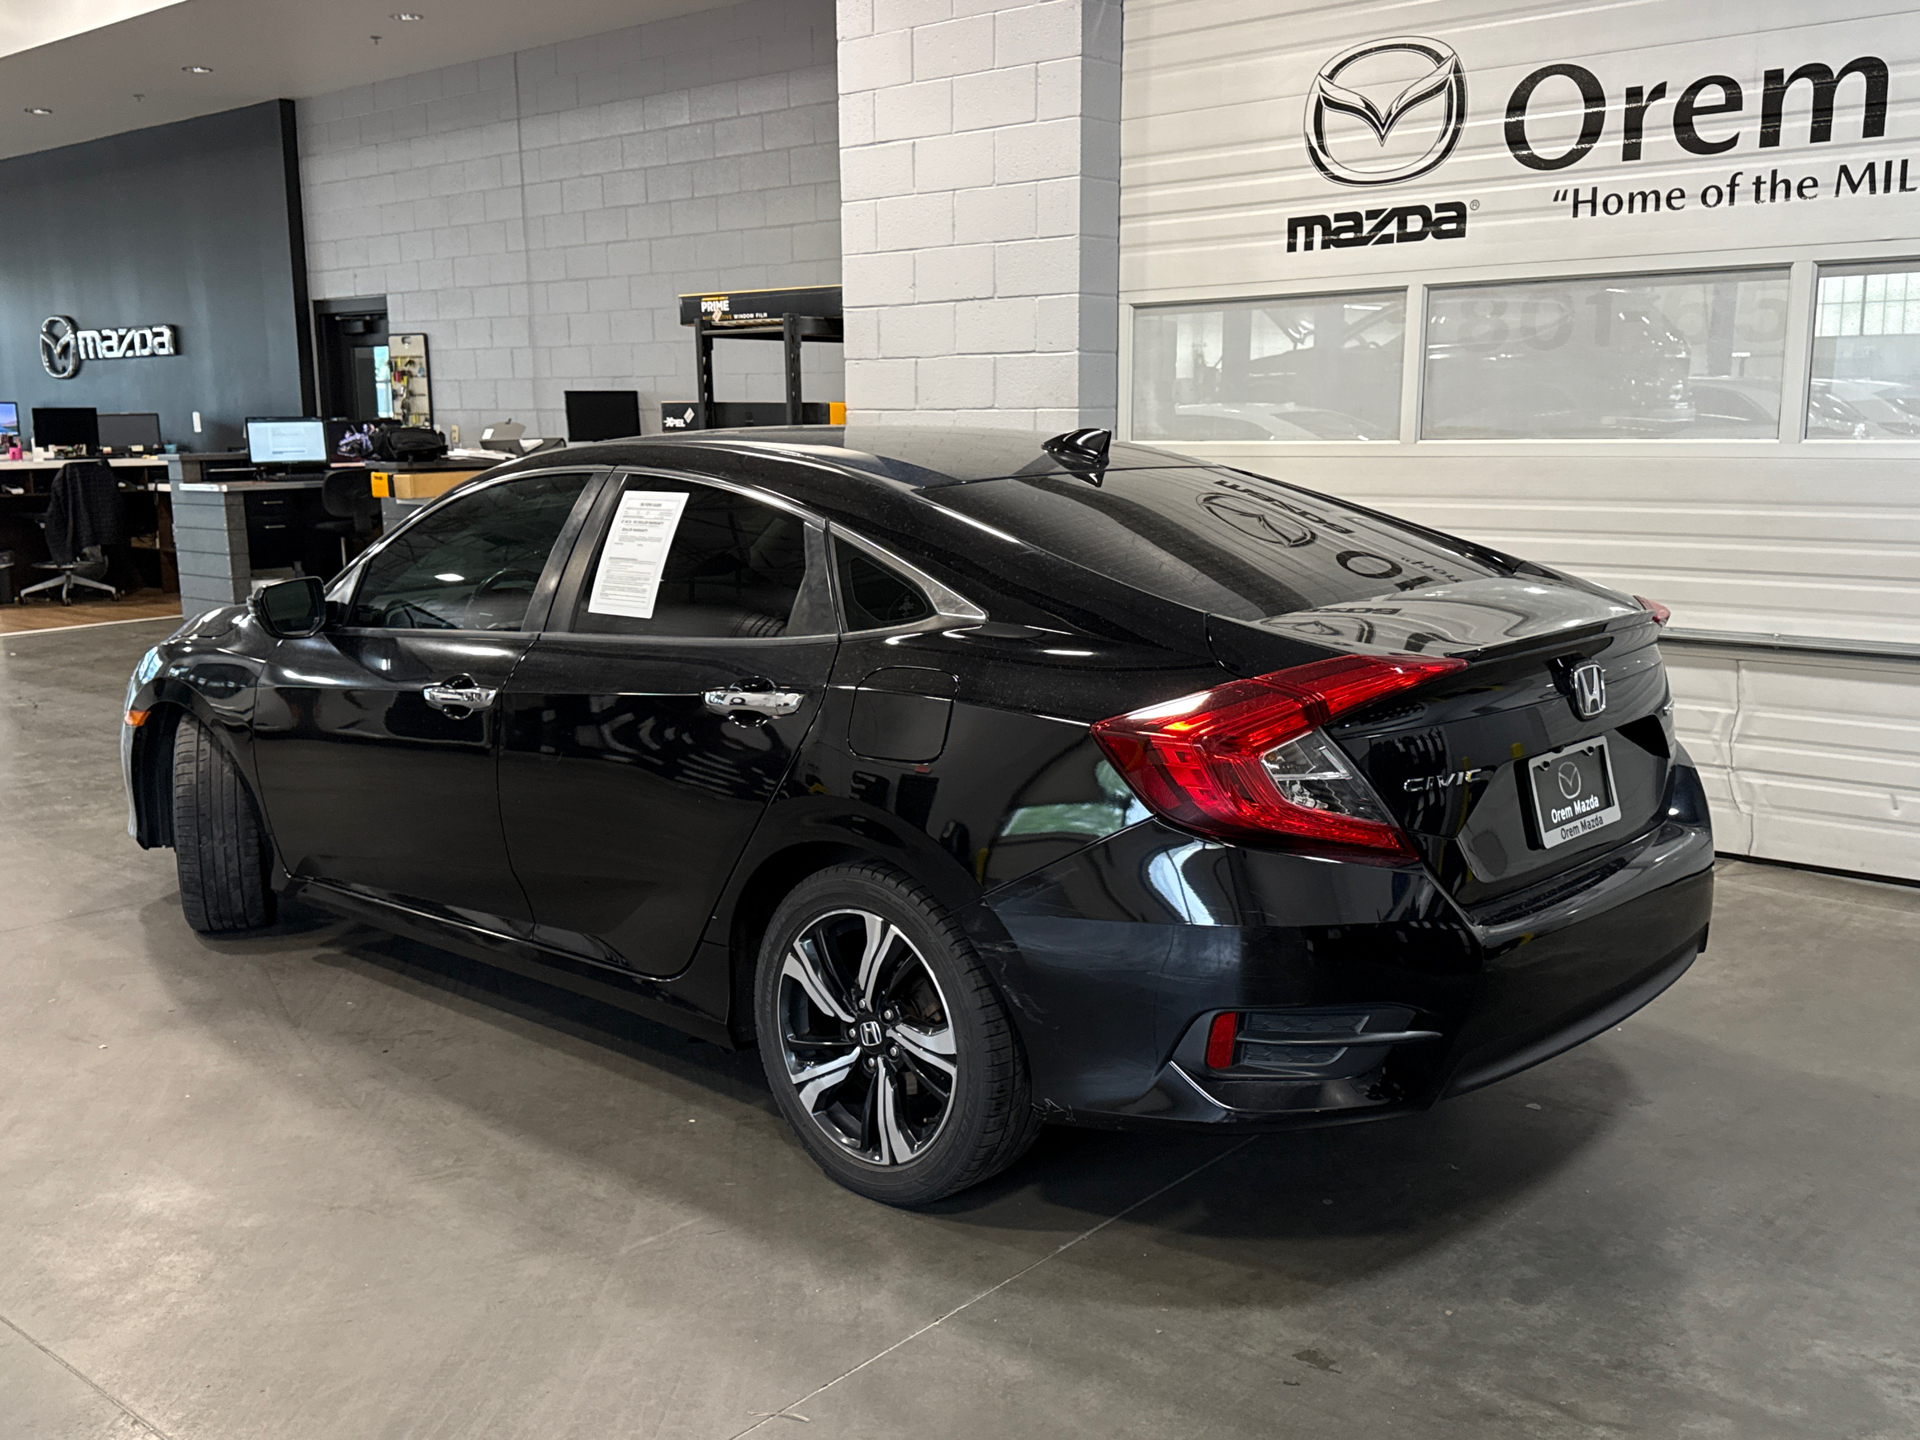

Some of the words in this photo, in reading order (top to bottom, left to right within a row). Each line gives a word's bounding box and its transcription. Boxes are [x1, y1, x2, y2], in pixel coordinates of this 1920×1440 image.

[1504, 56, 1889, 171] Orem
[1700, 171, 1743, 208] of
[1751, 168, 1819, 205] the
[1286, 201, 1467, 253] mazda
[701, 300, 730, 313] PRIME
[77, 324, 176, 360] mazda
[1403, 768, 1482, 792] CIVIC
[1551, 805, 1573, 824] Orem
[1573, 794, 1600, 815] Mazda
[1560, 824, 1580, 840] Orem
[1580, 814, 1604, 832] Mazda
